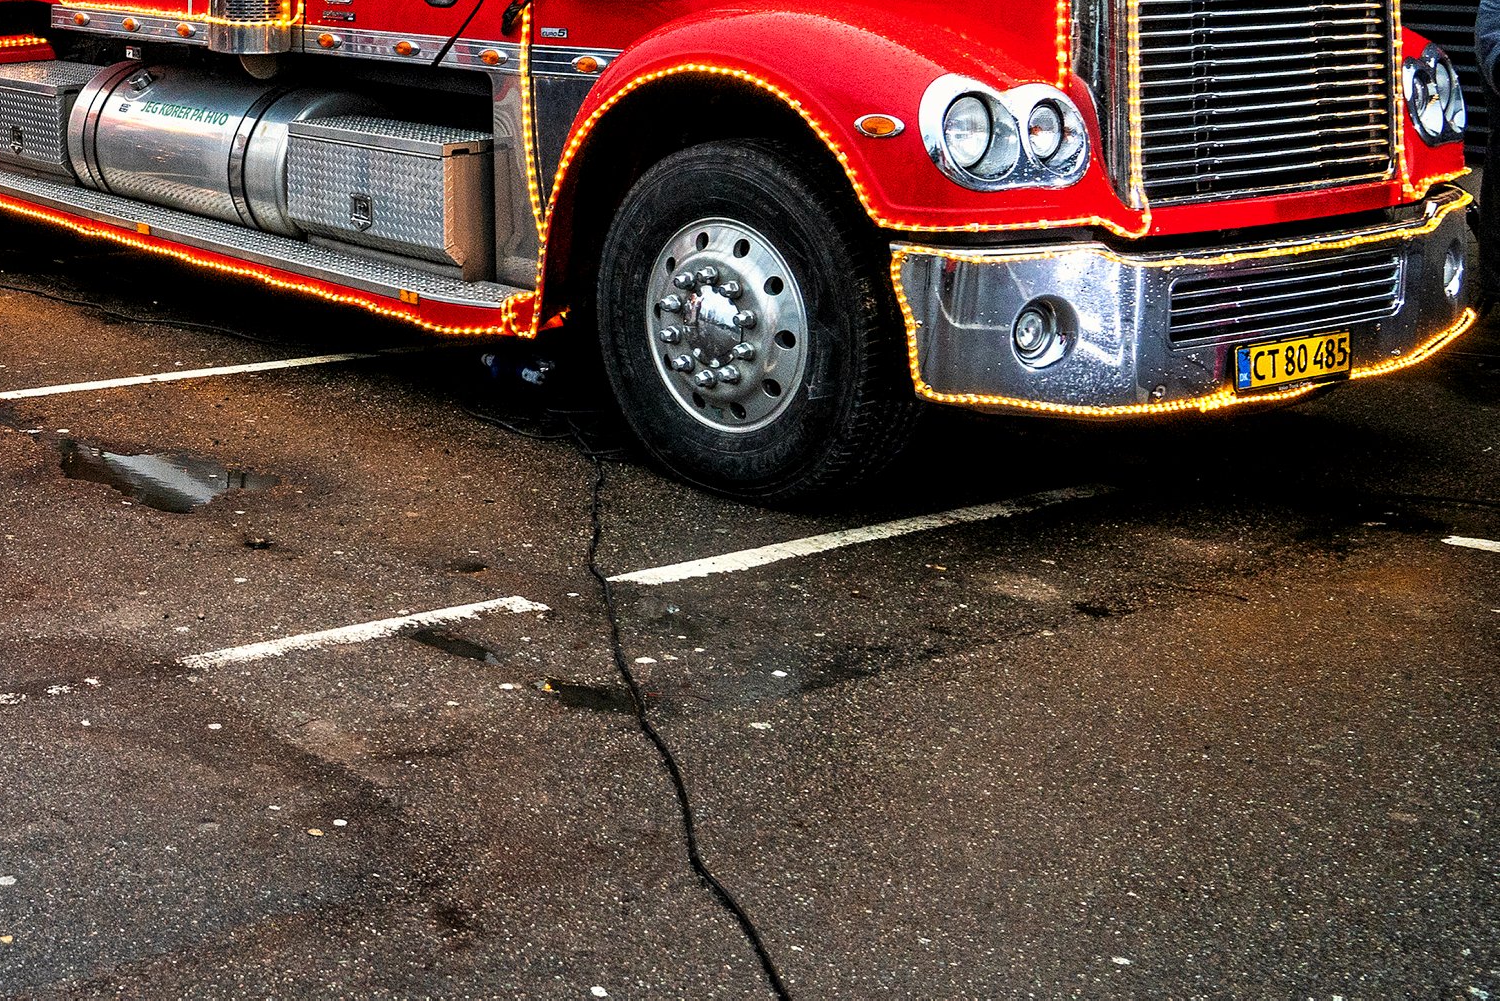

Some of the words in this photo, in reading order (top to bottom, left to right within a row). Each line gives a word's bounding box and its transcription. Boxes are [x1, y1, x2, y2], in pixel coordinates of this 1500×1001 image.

[141, 101, 161, 114] JEG
[159, 103, 191, 120] KØRER
[189, 107, 207, 122] PÅ
[204, 111, 229, 126] HVO
[1253, 349, 1279, 380] CT
[1284, 344, 1307, 376] 80
[1313, 337, 1348, 370] 485
[1239, 372, 1249, 381] DK
